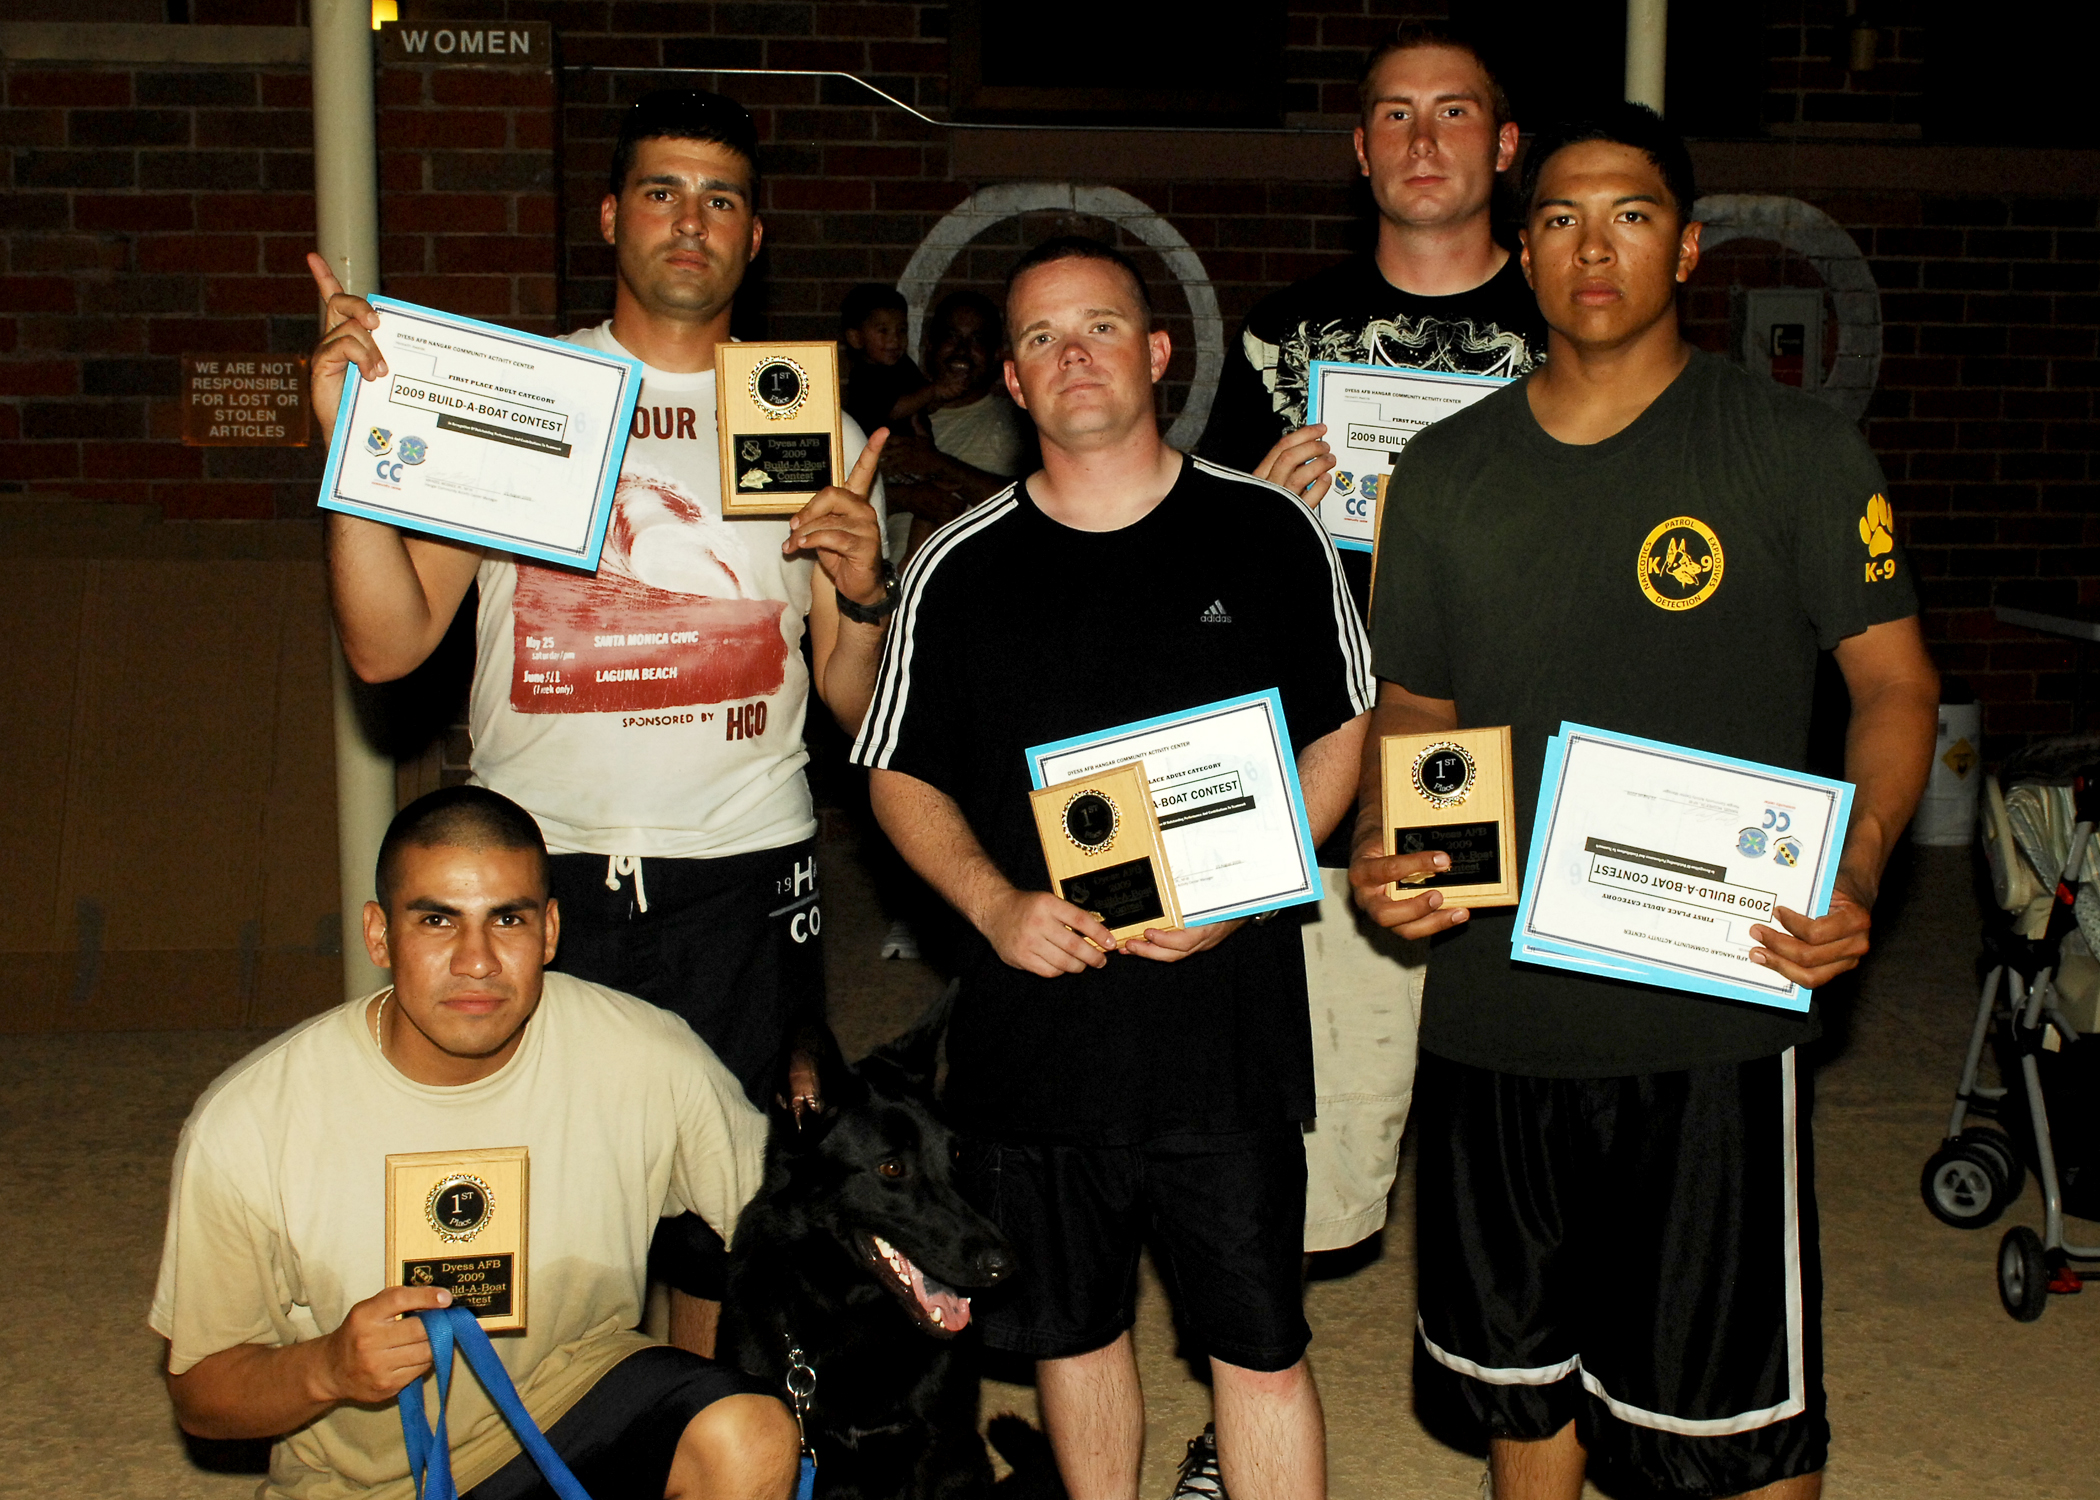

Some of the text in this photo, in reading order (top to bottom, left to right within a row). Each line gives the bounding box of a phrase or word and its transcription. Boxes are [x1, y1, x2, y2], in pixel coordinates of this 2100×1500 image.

[400, 29, 530, 54] WOMEN
[452, 346, 488, 358] COMMUNITY
[488, 355, 512, 365] ACTIVITY
[513, 361, 535, 370] CENTER
[195, 361, 294, 375] WE ARE NOT
[192, 377, 299, 390] RESPONSIBLE
[770, 371, 791, 392] 1ST
[448, 374, 556, 404] FIRST PLACE ADULT CATEGORY
[1392, 392, 1421, 400] COMMUNITY
[192, 393, 299, 406] FOR LOST OR
[769, 394, 790, 405] Place
[394, 384, 563, 432] 2009 BUILD-A-BOAT CONTEST
[214, 409, 277, 422] STOLEN
[209, 425, 286, 438] ARTICLES
[1350, 432, 1376, 442] 2009
[799, 438, 820, 447] AFB
[782, 450, 807, 458] 2009
[376, 460, 404, 483] CC
[763, 460, 826, 470] Build-A-Boat
[777, 471, 814, 481] Contest
[1345, 498, 1367, 517] CC
[1664, 518, 1695, 529] PATROL
[1639, 541, 1652, 591] NARCOTICS
[1647, 555, 1713, 574] K 9
[1708, 536, 1722, 588] EXPLOSIVES
[1864, 559, 1896, 583] K-9
[1655, 594, 1702, 608] DETECTION
[1200, 614, 1232, 624] adidas
[526, 636, 555, 650] May 25
[593, 630, 700, 648] SANTA MONICA CIVIC
[523, 670, 545, 684] June
[596, 666, 678, 683] LAGUNA BEACH
[622, 712, 715, 728] SPONSORED BY
[726, 700, 768, 741] HCO
[1067, 768, 1084, 776] DYESS
[1095, 760, 1116, 769] HANGAR
[1116, 752, 1148, 764] COMMUNITY
[1148, 746, 1170, 756] ACTIVITY
[1170, 741, 1191, 751] CENTER
[1166, 770, 1187, 781] ADULT
[1187, 762, 1222, 775] CATEGORY
[1435, 758, 1457, 780] 1ST
[1190, 780, 1238, 800] CONTEST
[1433, 782, 1455, 792] Place
[1762, 808, 1791, 832] CC
[1464, 827, 1488, 838] AFB
[1446, 840, 1473, 850] 2009
[1594, 864, 1772, 912] 2009 BUILD-A-BOAT CONTEST
[1602, 893, 1715, 924] FIRST PLACE ADULT CATEGORY
[790, 906, 820, 944] CO
[1623, 928, 1647, 939] CENTER
[1648, 934, 1673, 945] ACTIVITY
[1673, 940, 1710, 954] COMMUNITY
[1710, 948, 1735, 960] HANGAR
[450, 1192, 474, 1214] 1ST
[450, 1217, 472, 1228] Place
[442, 1260, 502, 1274] Dyess AFB
[457, 1272, 486, 1283] 2009
[451, 1282, 507, 1294] ild-A-Boat
